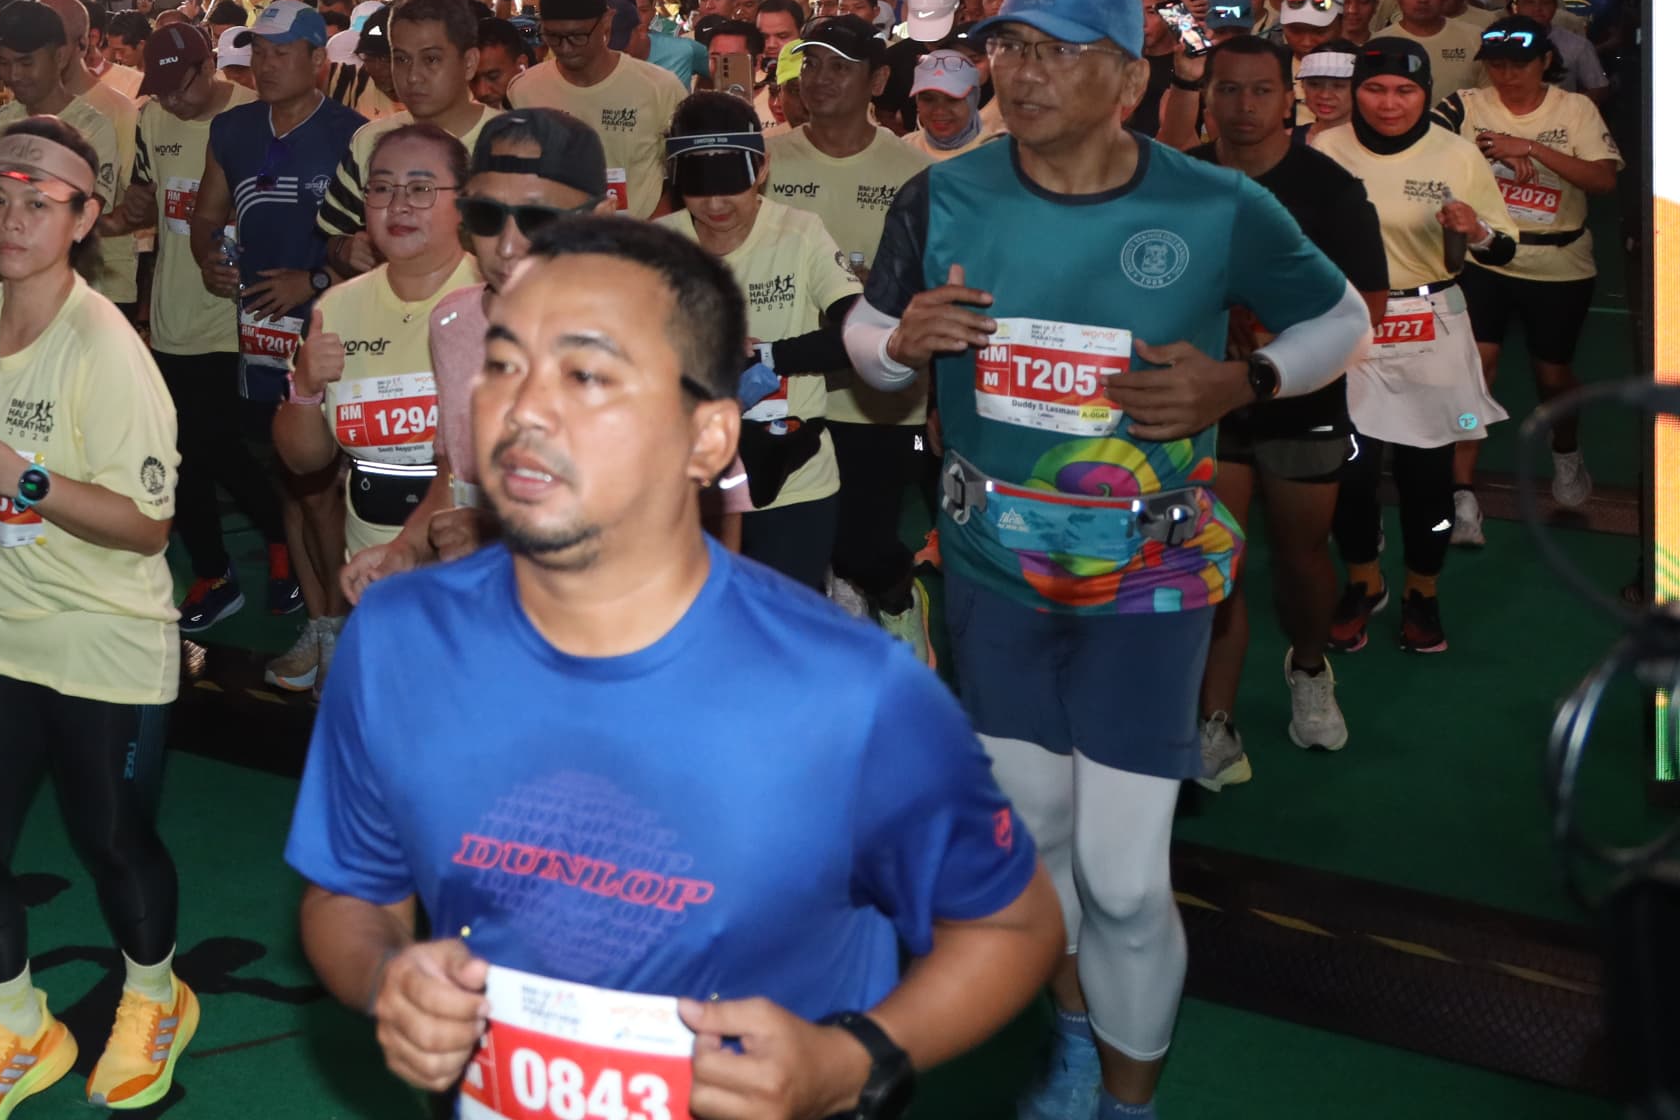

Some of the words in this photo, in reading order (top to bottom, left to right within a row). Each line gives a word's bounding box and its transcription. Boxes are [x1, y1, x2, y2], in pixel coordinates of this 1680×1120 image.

[155, 142, 183, 154] wondr
[773, 182, 820, 194] wondr
[256, 334, 298, 354] T201
[983, 372, 999, 386] M
[1012, 355, 1122, 396] T205
[340, 404, 362, 421] HM
[375, 405, 438, 436] 1294
[348, 429, 358, 441] F
[453, 832, 715, 912] DUNLOP
[510, 1047, 671, 1120] 0843
